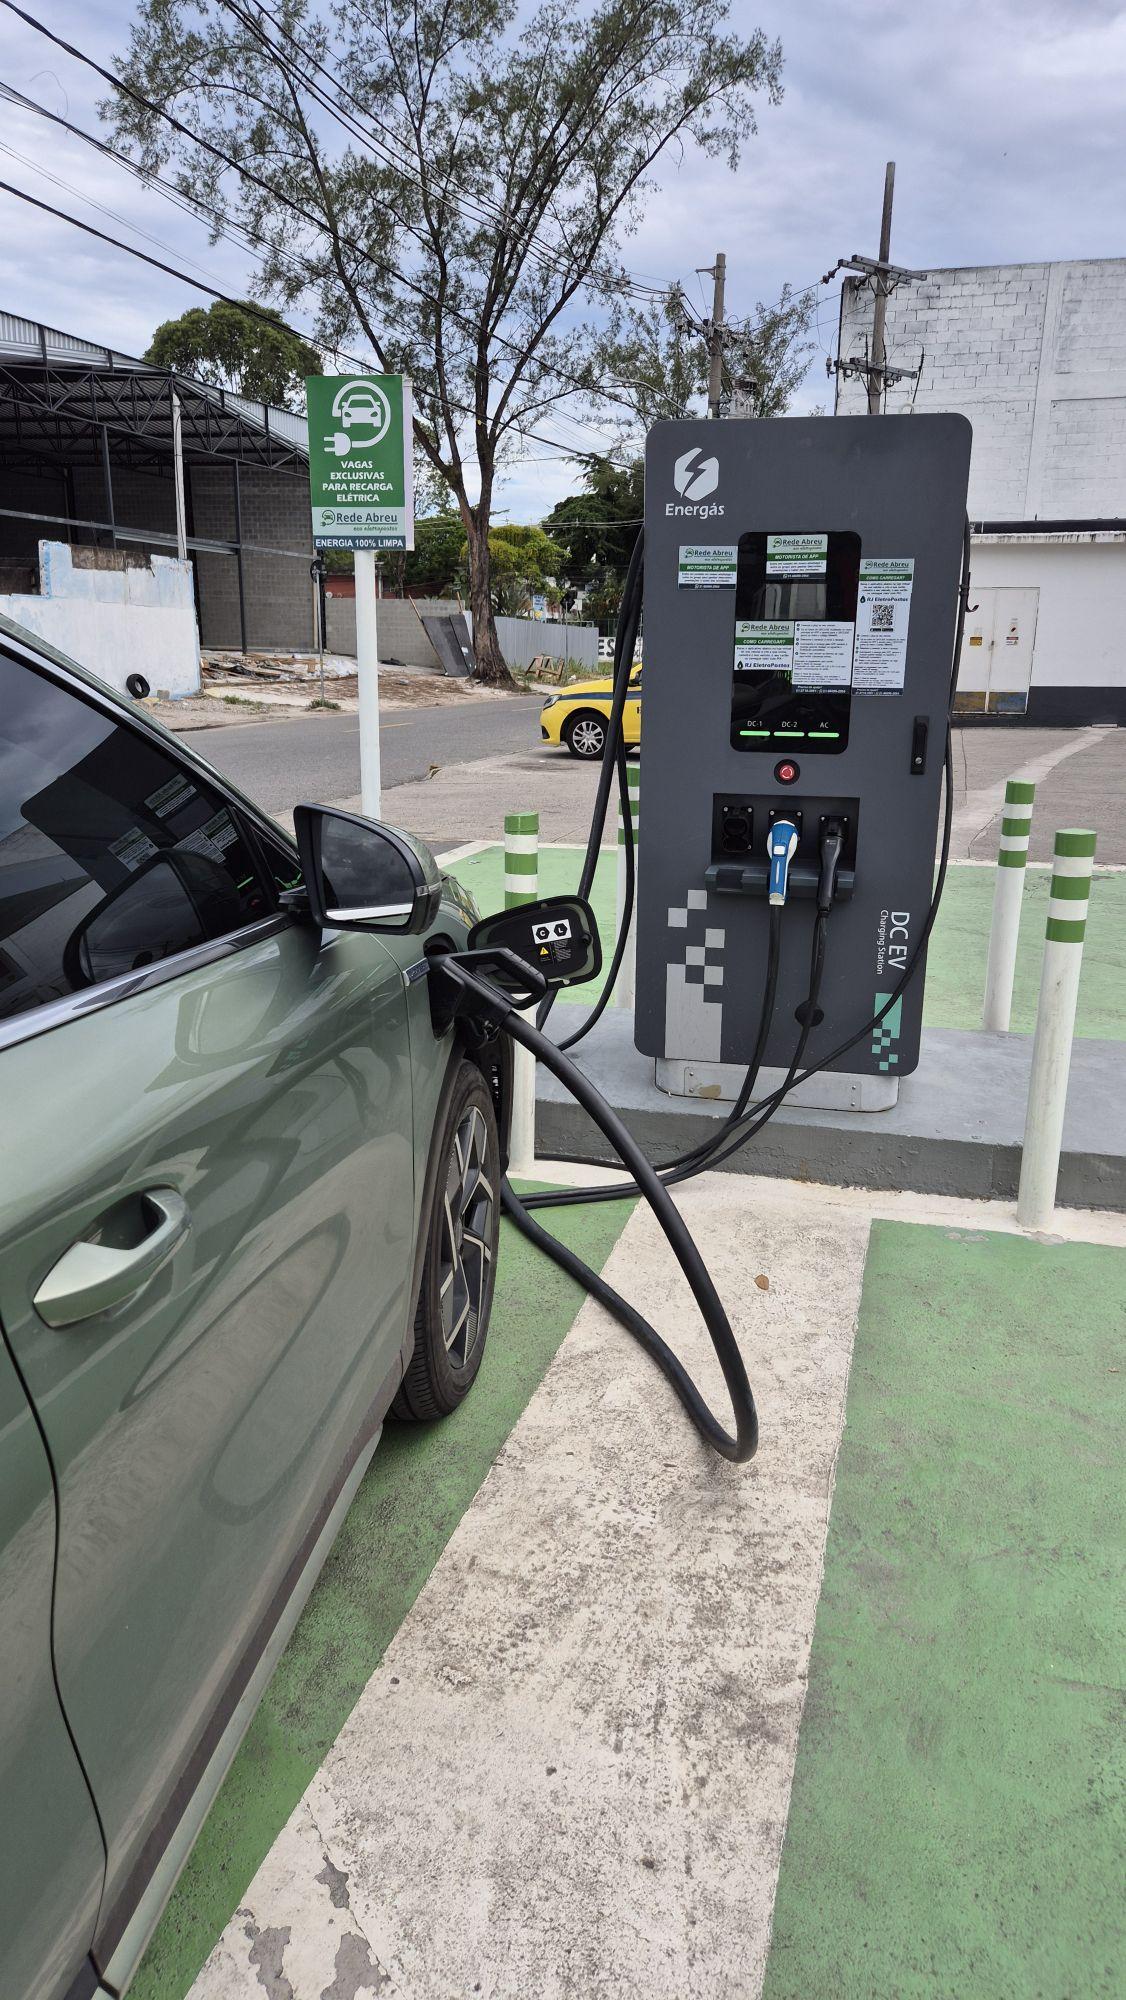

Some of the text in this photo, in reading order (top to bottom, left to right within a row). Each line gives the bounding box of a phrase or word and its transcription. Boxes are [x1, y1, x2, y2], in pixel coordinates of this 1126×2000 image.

[336, 493, 380, 501] ELÉTRICA
[665, 503, 725, 519] Energás
[337, 513, 398, 522] Rede Abreu
[316, 539, 353, 547] ENERGIA
[355, 539, 376, 547] 100%
[876, 909, 889, 975] Charging Station
[888, 912, 910, 970] DC EV
